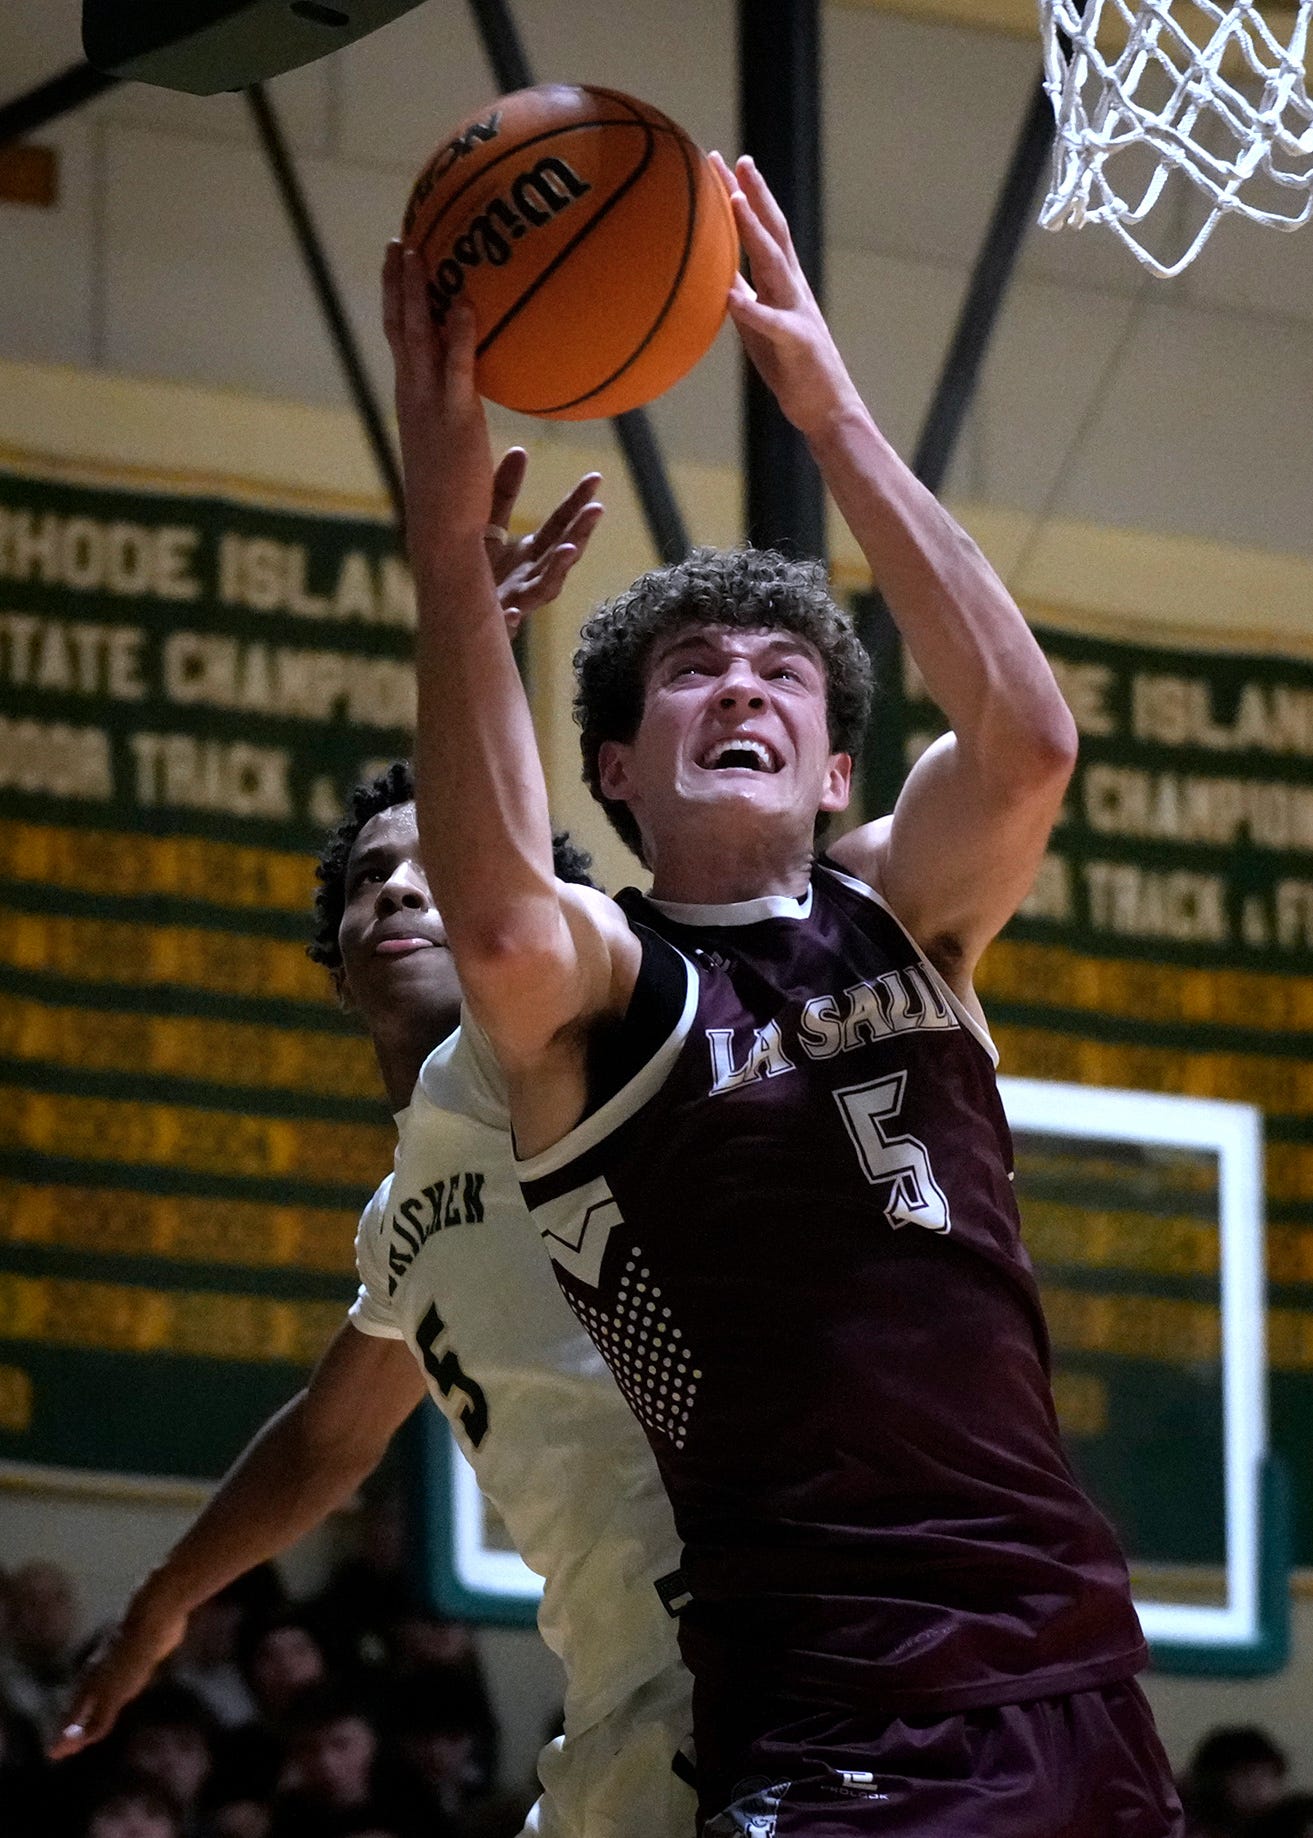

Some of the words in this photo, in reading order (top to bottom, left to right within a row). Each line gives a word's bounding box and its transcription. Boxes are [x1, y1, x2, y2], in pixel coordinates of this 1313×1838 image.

[424, 156, 592, 327] Wilson
[217, 531, 416, 628] ISLAN
[0, 611, 148, 700] TATE
[1132, 671, 1313, 754] ISLAN
[705, 1018, 797, 1098] LA
[832, 1069, 951, 1235] 5
[388, 1172, 485, 1298] RICKEN
[415, 1300, 489, 1449] 5
